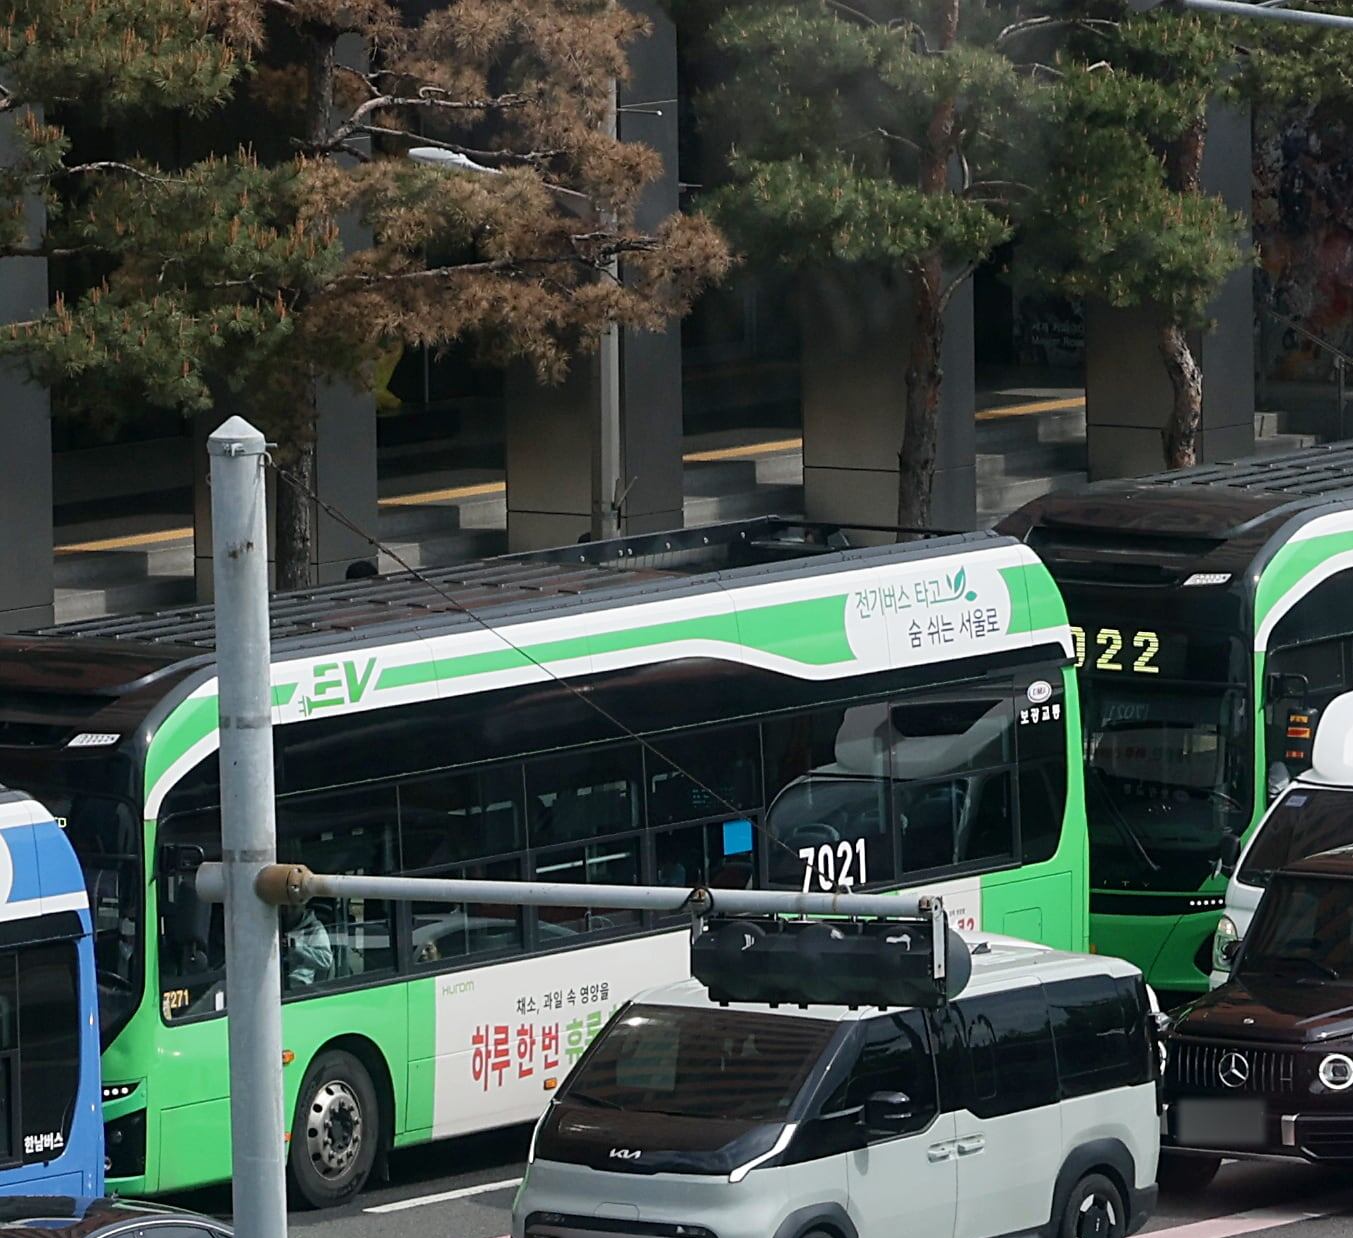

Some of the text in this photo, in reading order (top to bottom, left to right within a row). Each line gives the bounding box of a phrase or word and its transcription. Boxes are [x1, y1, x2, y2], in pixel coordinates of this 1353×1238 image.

[856, 579, 942, 620] 전기버스 타고
[908, 607, 1001, 648] 숨 쉬는 서울로
[799, 837, 867, 894] 7021
[516, 981, 610, 1015] 채소, 과일 속 영양을
[471, 1022, 560, 1092] 하루 한 번
[24, 1131, 65, 1154] 한남버스
